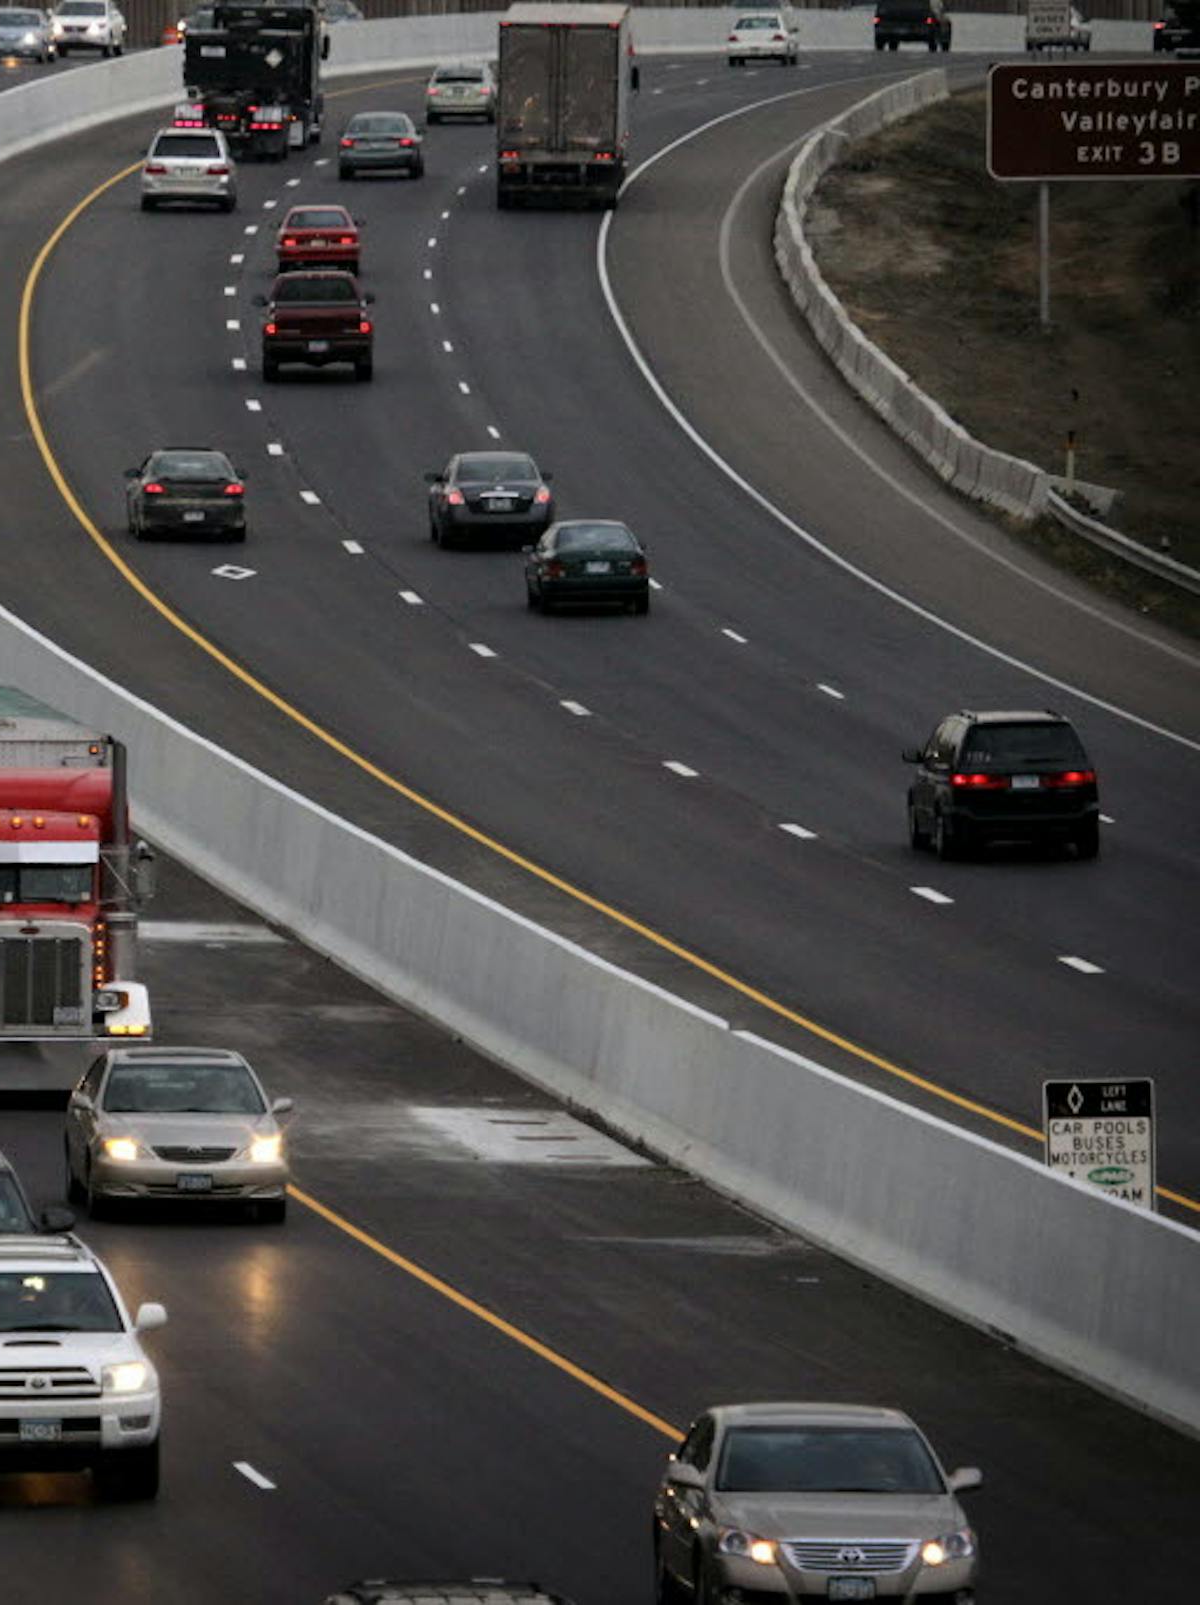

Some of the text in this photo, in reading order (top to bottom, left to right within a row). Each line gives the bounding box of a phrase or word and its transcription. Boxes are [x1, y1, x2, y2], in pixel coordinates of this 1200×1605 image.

[1011, 76, 1200, 102] Canterbury P
[1061, 109, 1197, 136] Valleyfair
[1077, 141, 1180, 164] EXIT 3B
[1052, 1121, 1146, 1135] CAR POOLS
[1073, 1136, 1125, 1150] BUSES
[1052, 1150, 1147, 1165] MOTORCYCLES
